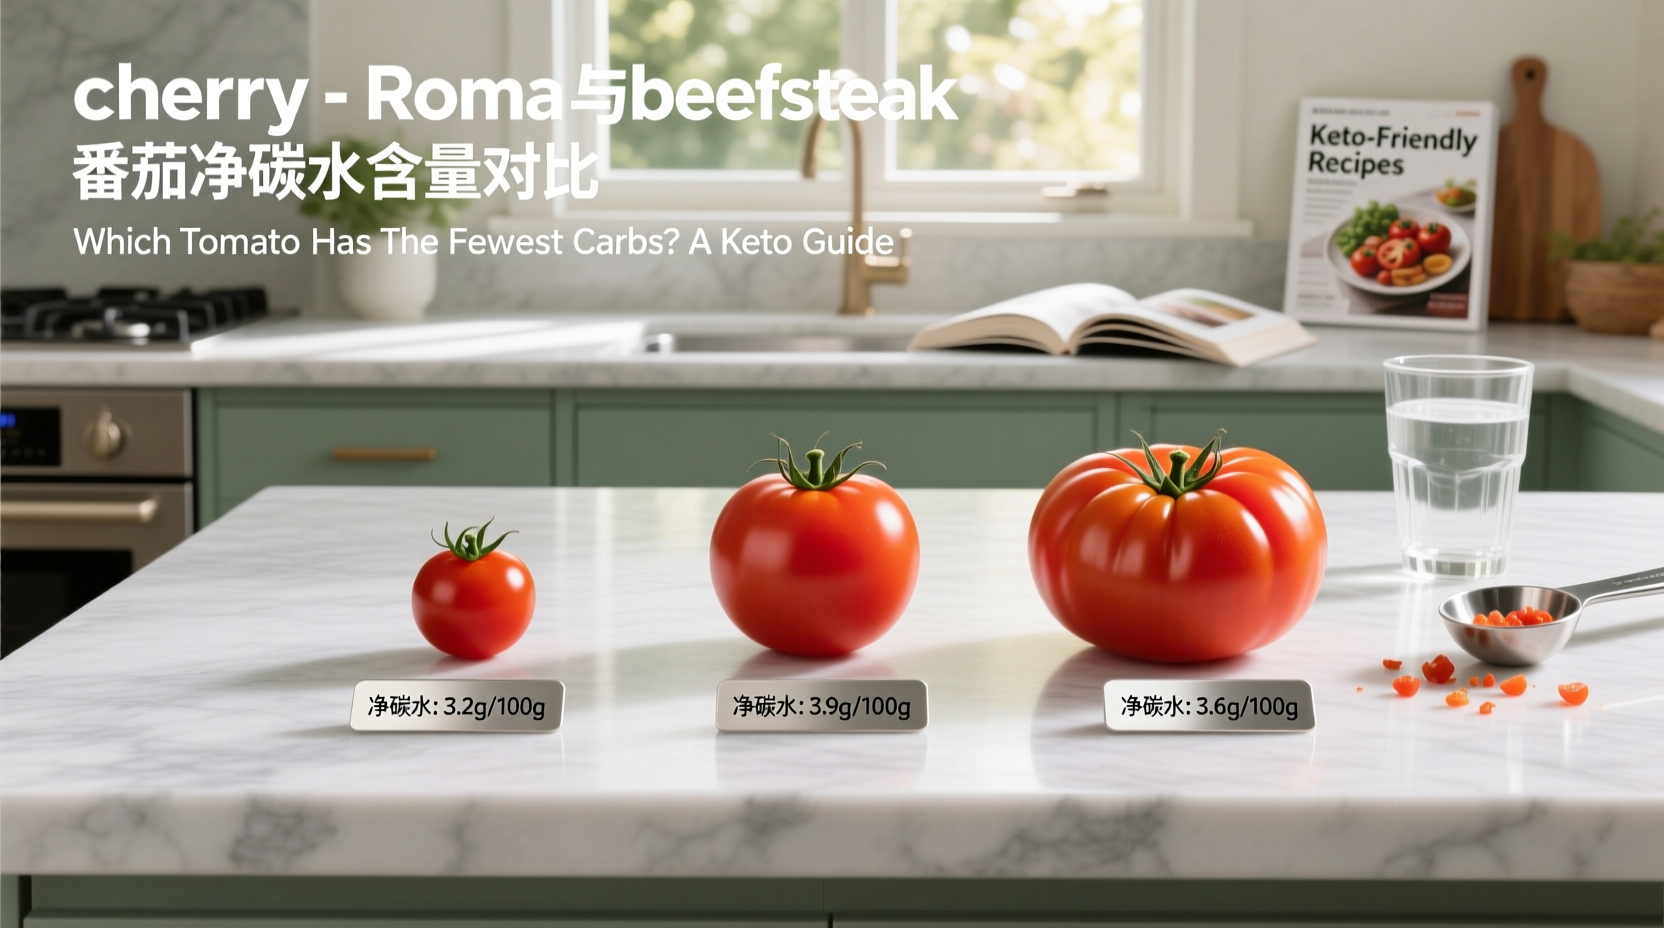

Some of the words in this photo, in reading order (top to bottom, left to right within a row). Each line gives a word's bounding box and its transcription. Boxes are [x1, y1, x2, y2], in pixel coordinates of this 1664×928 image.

[1310, 124, 1478, 158] Keto-Friendly
[1308, 151, 1404, 180] Recipes
[443, 695, 546, 721] 3.2g/100g
[809, 695, 911, 721] 3.9g/100g
[1196, 695, 1299, 721] 3.6g/100g
